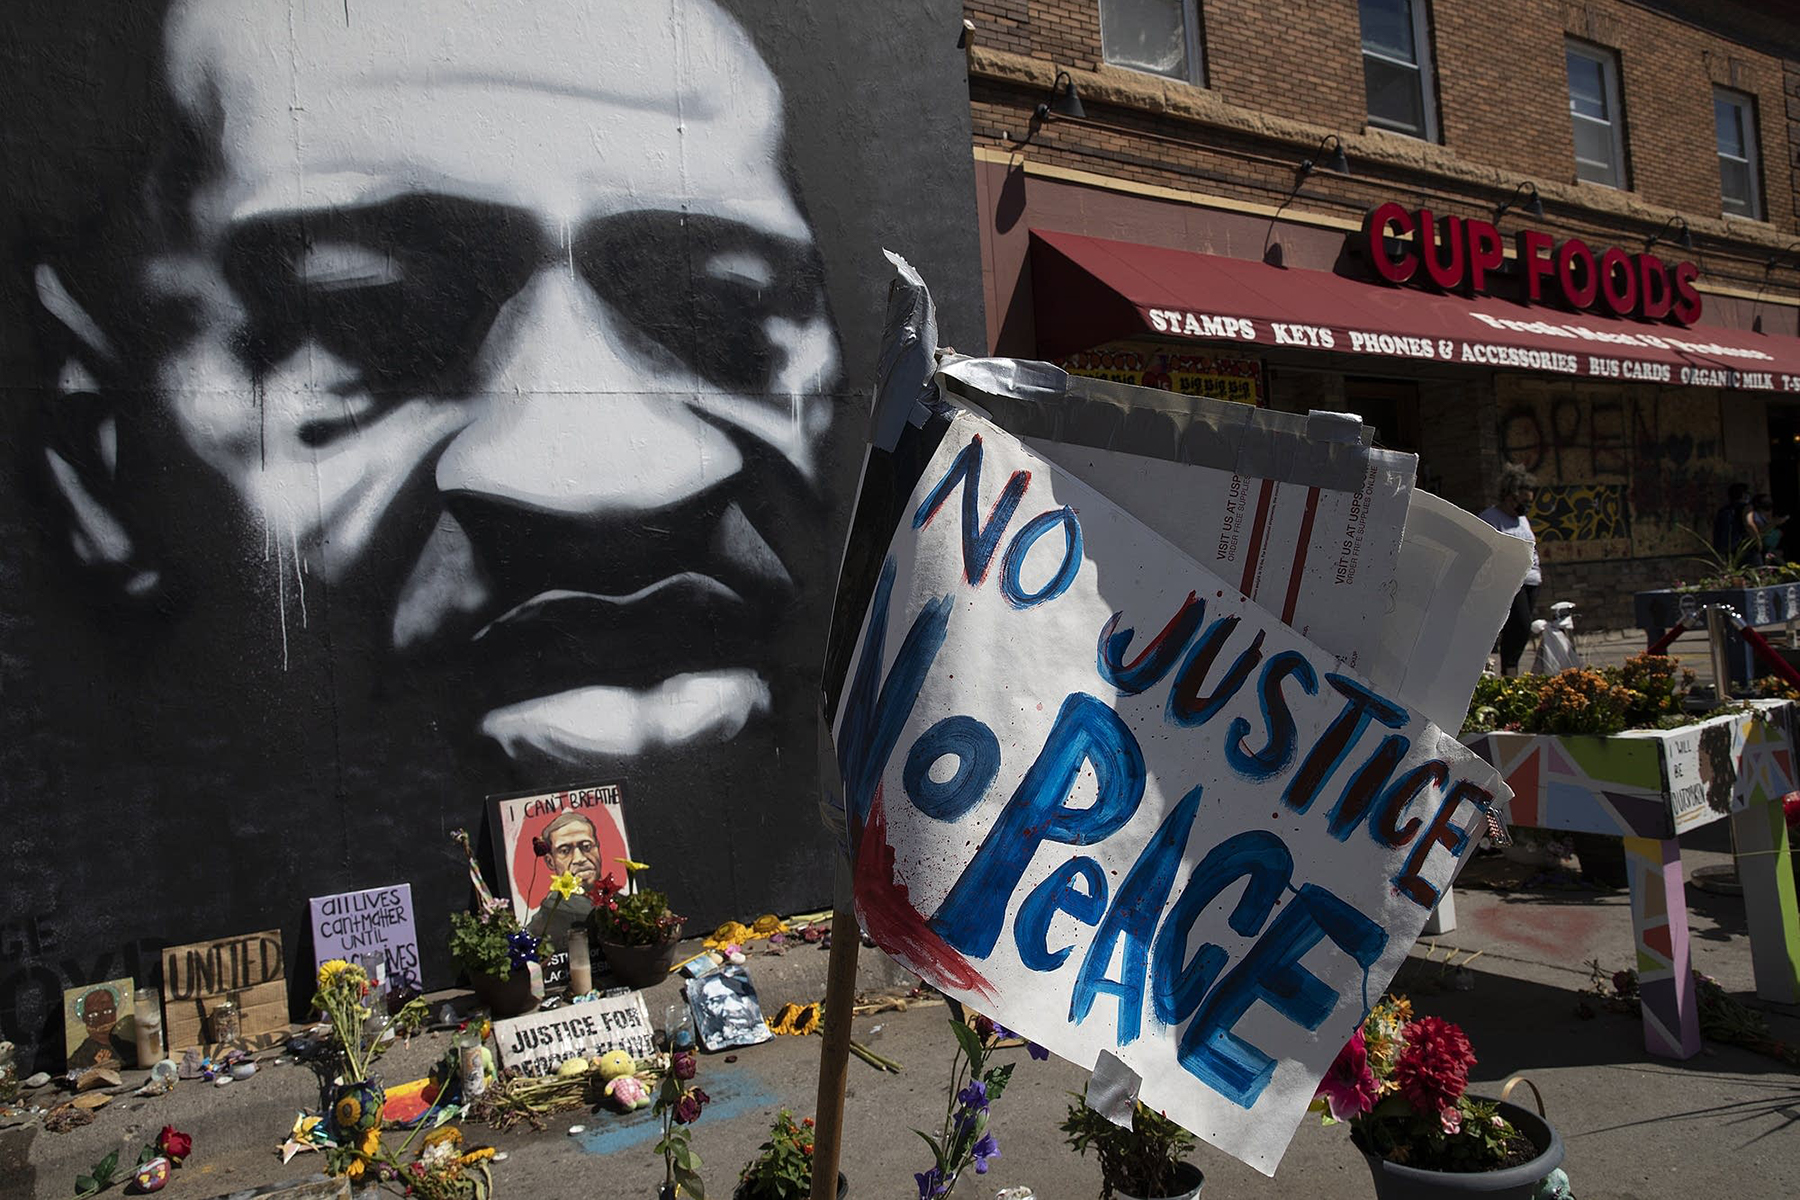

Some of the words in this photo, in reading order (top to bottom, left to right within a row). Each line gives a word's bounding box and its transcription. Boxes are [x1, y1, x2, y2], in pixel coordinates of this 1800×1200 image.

[1362, 202, 1503, 291] CUP
[1516, 228, 1703, 325] FOODS
[1149, 308, 1256, 341] STAMPS
[1271, 322, 1336, 349] KEYS
[1349, 330, 1436, 359] PHONES
[1437, 339, 1454, 360] &
[1461, 342, 1578, 374] ACCESSORIES
[1588, 355, 1620, 378] BUS
[1622, 360, 1672, 383] CARDS
[1680, 366, 1742, 389] ORGANIC
[1742, 371, 1775, 391] MILK
[1237, 474, 1251, 511] SUPPLIES
[1365, 465, 1377, 494] ONLINE
[1226, 500, 1236, 513] AT
[1356, 496, 1371, 533] SUPPLIES
[912, 433, 1084, 610] NO
[1222, 515, 1233, 531] US
[1232, 512, 1243, 532] FREE
[1345, 524, 1355, 537] AT
[1216, 533, 1230, 560] VISIT
[1227, 534, 1238, 561] ORDER
[1341, 539, 1353, 555] US
[1352, 536, 1362, 555] FREE
[1335, 557, 1349, 585] VISIT
[1346, 557, 1358, 584] ORDER
[1097, 590, 1492, 909] JUSTICE
[509, 805, 515, 822] I
[524, 793, 569, 819] CAN'T
[569, 787, 620, 809] BREATHE
[168, 938, 282, 1000] UNITED
[511, 1016, 598, 1054] JUSTICE
[600, 1007, 642, 1031] FOR
